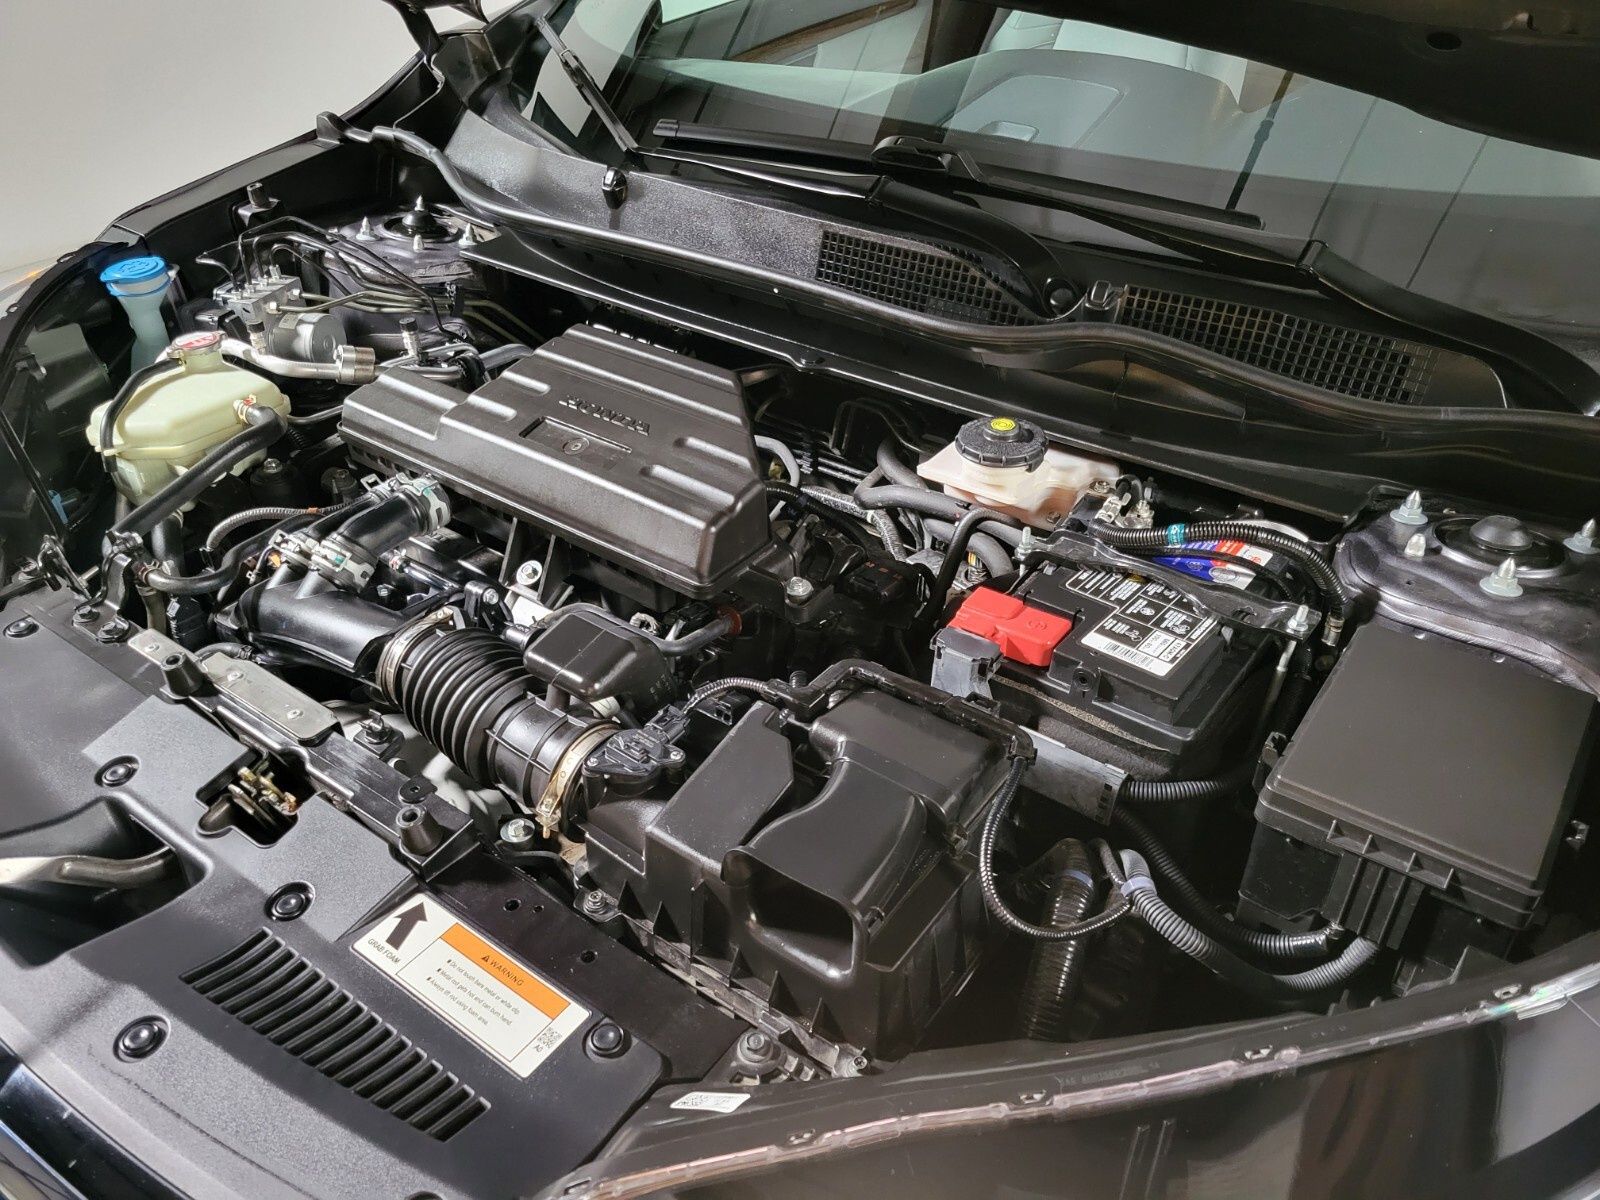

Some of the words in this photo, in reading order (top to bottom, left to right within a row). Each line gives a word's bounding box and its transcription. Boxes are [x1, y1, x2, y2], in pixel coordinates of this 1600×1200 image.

[558, 395, 650, 436] HONDA
[368, 938, 385, 952] GRAB
[383, 949, 401, 963] FOAM
[490, 960, 525, 986] WARNING
